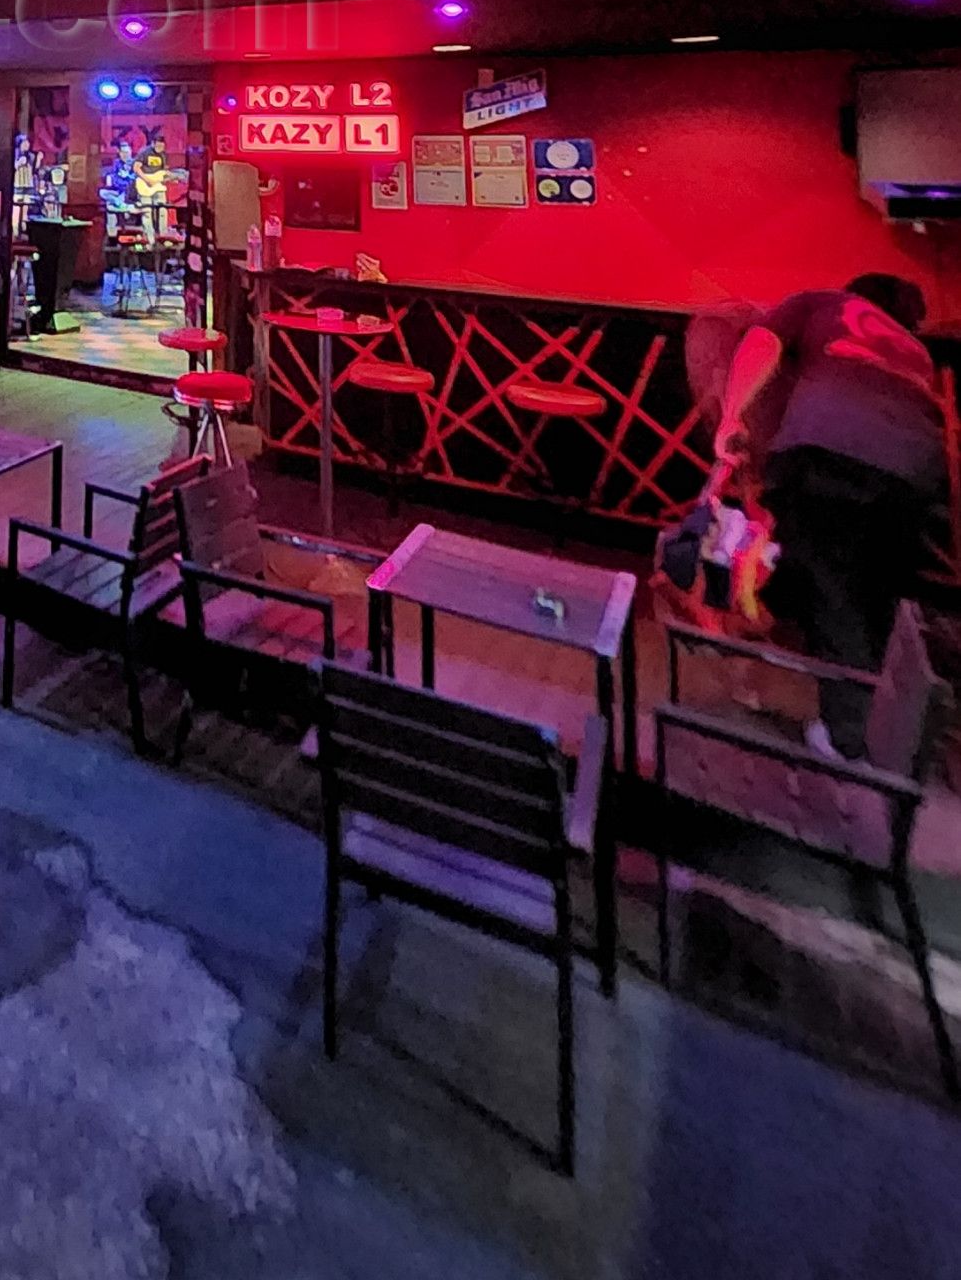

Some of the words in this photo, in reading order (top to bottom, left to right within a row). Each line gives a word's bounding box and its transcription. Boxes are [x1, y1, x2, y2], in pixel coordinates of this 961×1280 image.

[245, 84, 335, 109] KOZY
[349, 81, 393, 107] L2
[477, 97, 534, 121] LIGHT
[246, 123, 333, 145] KAZY
[353, 123, 389, 146] L1
